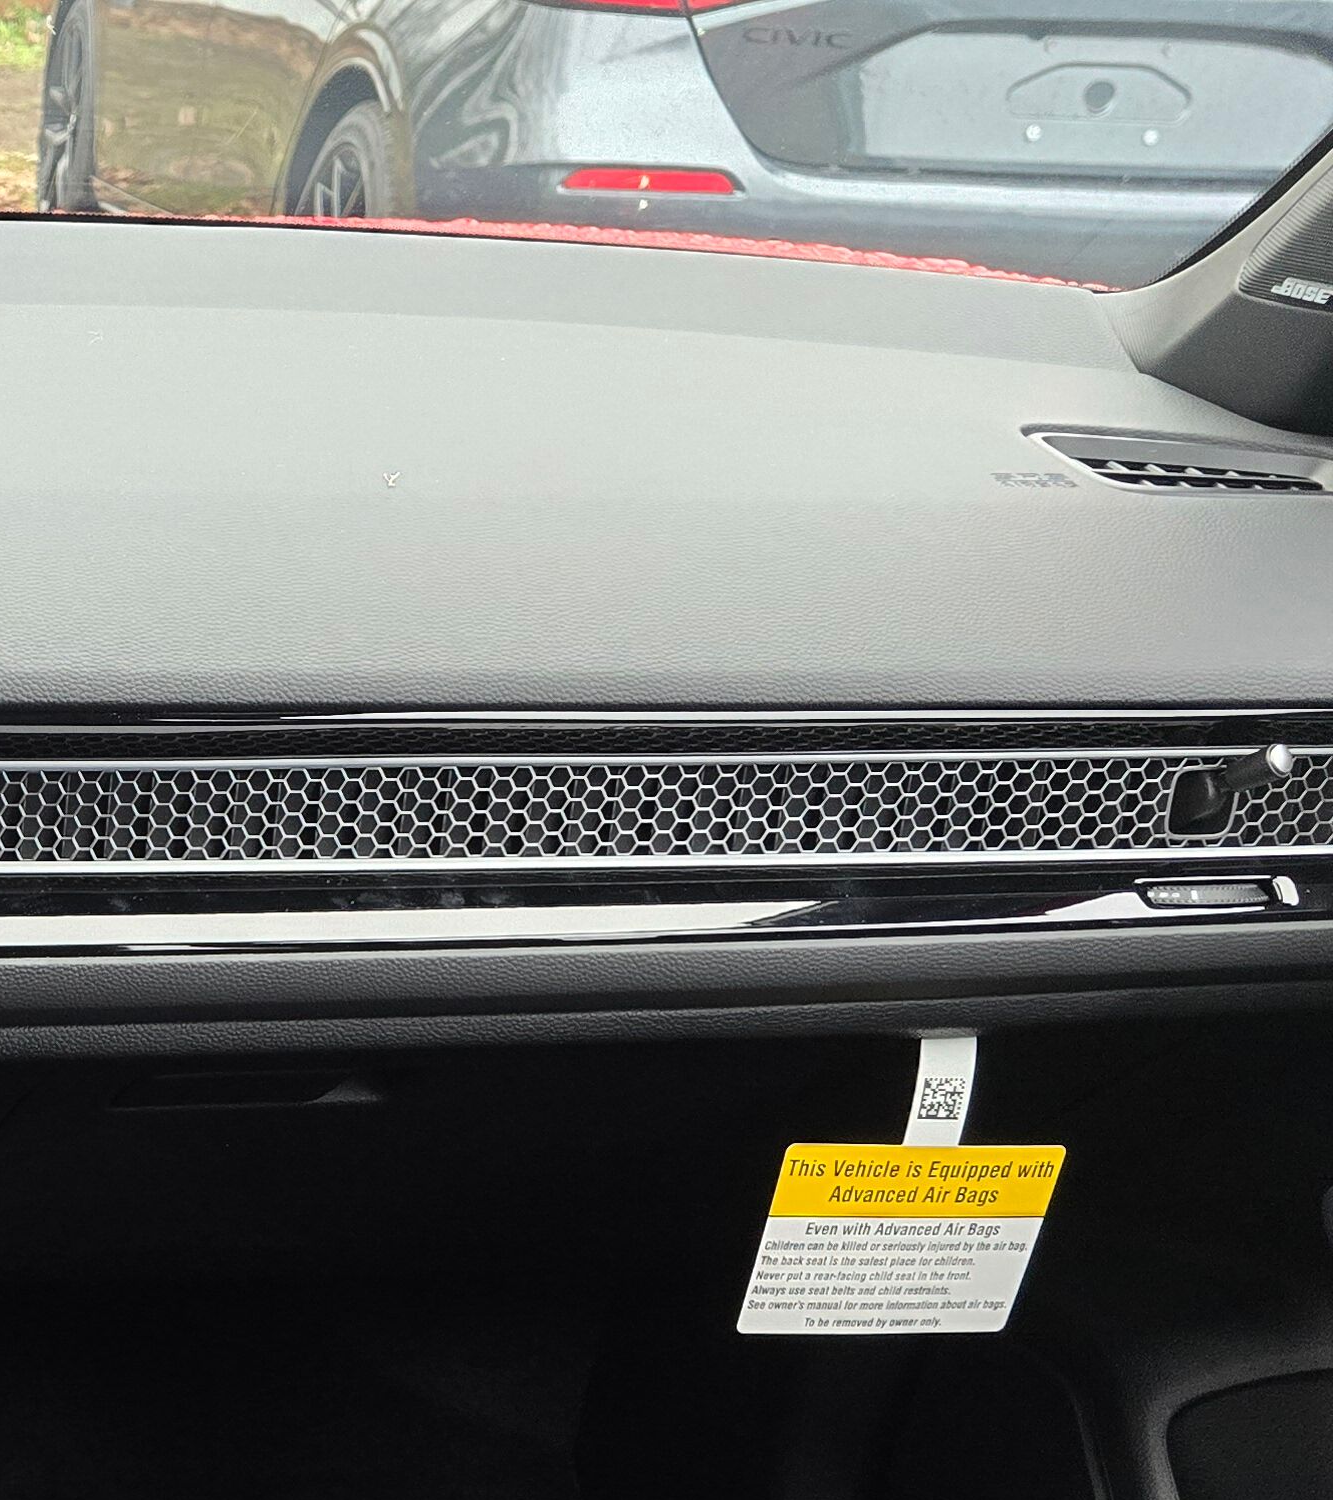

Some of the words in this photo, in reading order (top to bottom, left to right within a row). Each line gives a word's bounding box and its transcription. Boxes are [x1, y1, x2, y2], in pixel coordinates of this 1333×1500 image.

[743, 27, 853, 50] CIVIC
[1271, 277, 1333, 305] BOSE
[789, 1159, 827, 1177] This
[834, 1159, 900, 1178] Vehicle
[906, 1160, 923, 1178] is
[928, 1160, 1014, 1182] Equipped
[1017, 1160, 1055, 1178] with
[828, 1185, 919, 1203] Advanced
[921, 1186, 951, 1203] Air
[955, 1186, 999, 1207] Bags
[805, 1222, 838, 1236] Even
[842, 1222, 872, 1236] with
[874, 1222, 942, 1236] Advanced
[943, 1223, 965, 1236] Air
[967, 1223, 1001, 1239] Bags
[764, 1241, 805, 1251] Children
[807, 1243, 825, 1251] can
[826, 1241, 839, 1251] be
[840, 1241, 869, 1251] killed
[870, 1243, 881, 1251] or
[881, 1241, 925, 1253] seriously
[927, 1241, 962, 1253] injured
[962, 1241, 974, 1253] by
[975, 1242, 991, 1251] the
[992, 1242, 1006, 1251] air
[1008, 1241, 1028, 1253] bag.
[761, 1255, 777, 1265] The
[780, 1256, 804, 1266] back
[805, 1257, 828, 1266] seat
[829, 1256, 838, 1266] is
[840, 1256, 857, 1266] the
[858, 1256, 888, 1266] safest
[889, 1256, 916, 1268] place
[918, 1256, 932, 1266] for
[934, 1256, 976, 1266] children.
[755, 1271, 785, 1280] Never
[786, 1271, 803, 1282] put
[804, 1272, 811, 1280] a
[813, 1271, 867, 1283] rear-facing
[869, 1271, 893, 1281] child
[894, 1271, 915, 1281] seat
[917, 1271, 927, 1280] in
[929, 1271, 945, 1281] the
[946, 1271, 972, 1281] front.
[751, 1285, 787, 1296] Always
[788, 1287, 806, 1296] use
[807, 1286, 829, 1296] seat
[831, 1286, 855, 1296] belts
[857, 1286, 876, 1296] and
[878, 1286, 902, 1295] child
[903, 1286, 951, 1296] restraints.
[747, 1299, 765, 1310] See
[768, 1300, 804, 1310] owner's
[806, 1300, 842, 1310] manual
[843, 1300, 856, 1310] for
[858, 1302, 884, 1310] more
[885, 1300, 938, 1310] information
[940, 1300, 966, 1310] about
[967, 1300, 981, 1310] air
[982, 1300, 1007, 1311] bags.
[805, 1317, 815, 1327] To
[817, 1318, 830, 1327] be
[831, 1318, 874, 1327] removed
[876, 1318, 887, 1328] by
[889, 1319, 918, 1327] owner
[920, 1317, 942, 1328] only.
